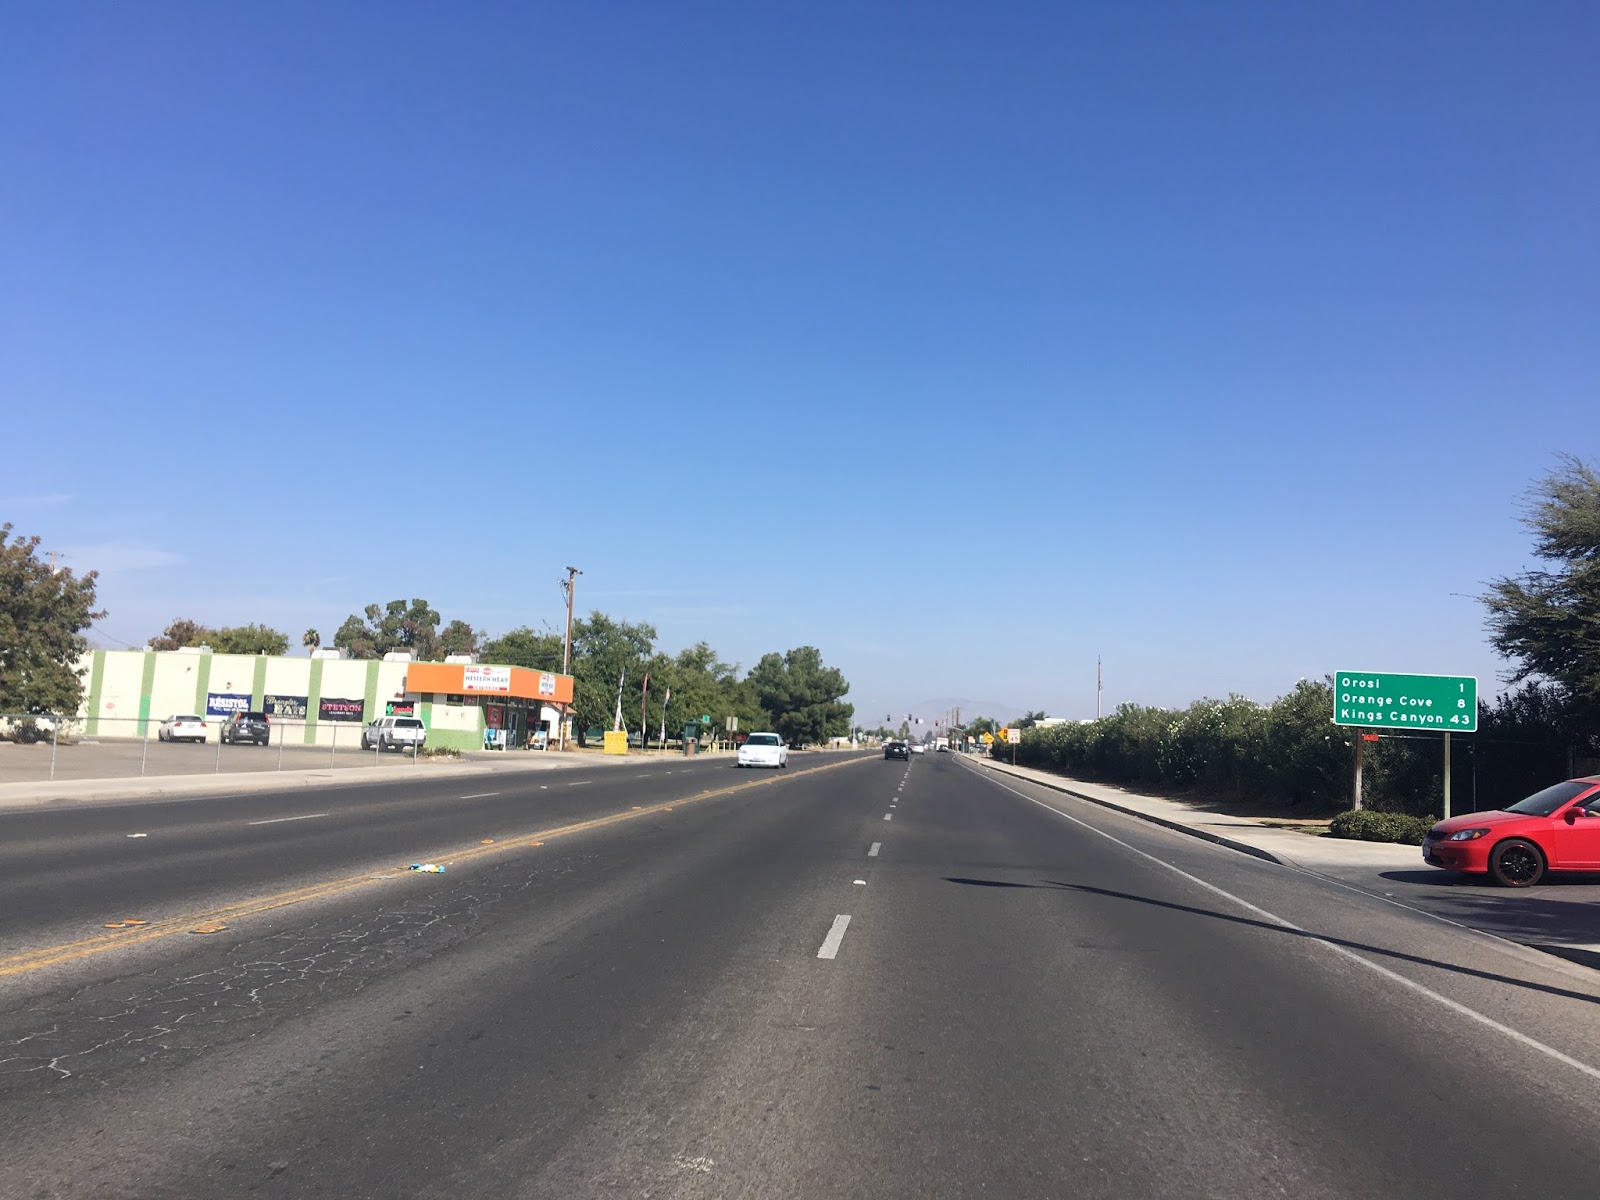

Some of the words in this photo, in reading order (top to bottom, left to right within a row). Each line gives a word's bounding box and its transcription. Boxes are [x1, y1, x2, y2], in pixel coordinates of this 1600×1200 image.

[1342, 677, 1380, 689] Orosi
[1459, 683, 1464, 692] 1
[209, 697, 248, 708] RESISTOL
[322, 704, 361, 712] STETSON
[1342, 693, 1393, 707] Orange
[1399, 695, 1433, 707] Cove
[1457, 699, 1466, 709] 8
[1341, 708, 1383, 722] Kings
[1390, 711, 1443, 724] Canyon
[1450, 714, 1470, 724] 43
